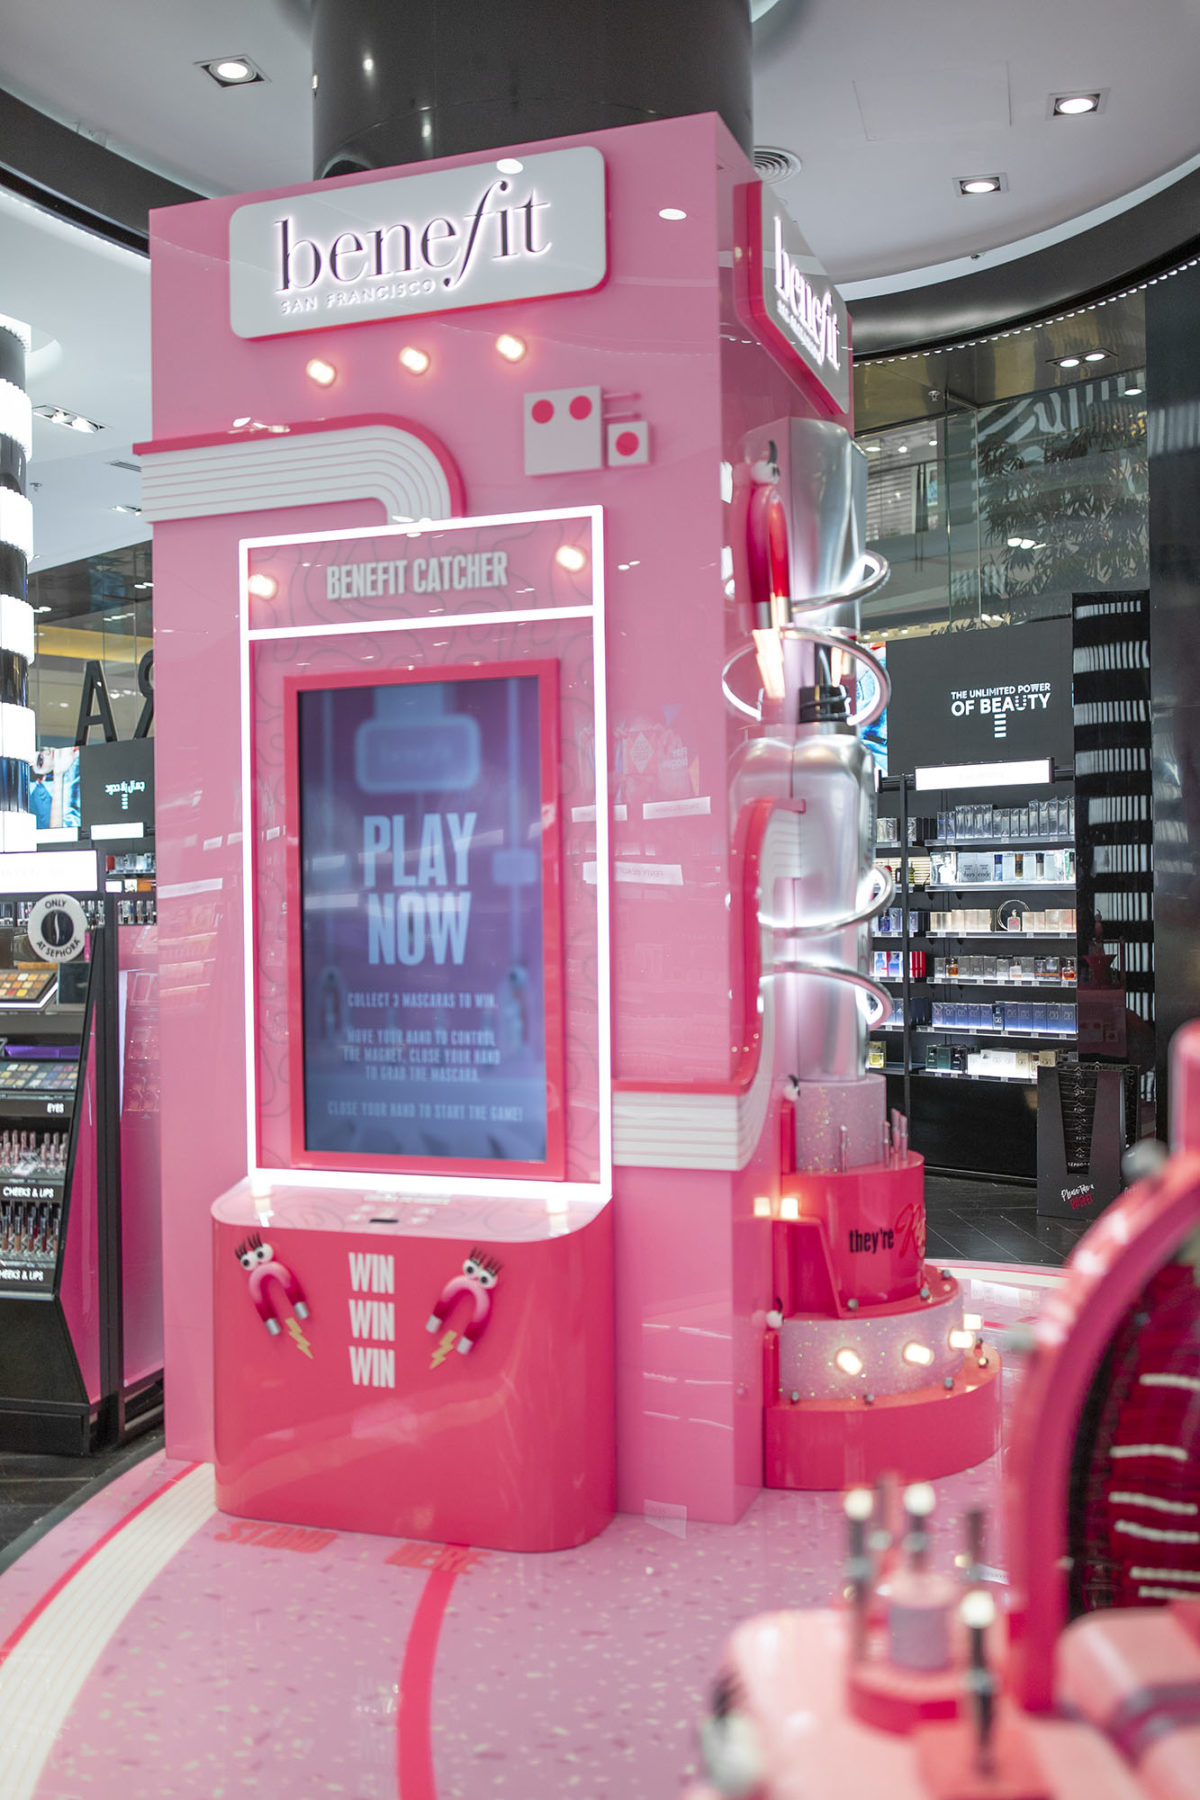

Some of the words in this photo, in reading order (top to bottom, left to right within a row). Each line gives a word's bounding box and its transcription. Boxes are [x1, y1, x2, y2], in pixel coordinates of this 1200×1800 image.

[274, 180, 552, 292] benefit
[280, 295, 318, 316] SAN
[327, 278, 436, 309] FRANCISCO
[774, 215, 841, 370] benefit
[326, 559, 407, 600] BENEFIT
[413, 551, 508, 594] CATCHER
[951, 689, 968, 700] THE
[969, 686, 1016, 699] UNLIMITED
[1018, 682, 1051, 694] POWER
[951, 700, 975, 717] OF
[980, 692, 1051, 714] BEAUTY
[363, 812, 478, 887] PLAY
[45, 898, 67, 909] ONLY
[368, 891, 472, 966] NOW
[36, 941, 46, 951] AT
[45, 938, 80, 958] SEPHORA
[347, 992, 389, 1008] COLLECT
[402, 993, 455, 1008] MASCARAS
[458, 994, 470, 1008] TO
[346, 1029, 372, 1044] MOVE
[377, 1029, 402, 1045] YOUR
[435, 1030, 448, 1045] TO
[343, 1047, 361, 1062] THE
[444, 1048, 471, 1064] YOUR
[365, 1065, 377, 1081] TO
[47, 1102, 65, 1114] EYES
[327, 1100, 358, 1116] CLOSE
[361, 1101, 387, 1117] YOUR
[419, 1103, 431, 1119] TO
[434, 1103, 465, 1120] START
[469, 1104, 487, 1120] THE
[2, 1185, 31, 1198] CHEEKS
[39, 1187, 55, 1199] LIPS
[848, 1227, 895, 1255] they're
[0, 1268, 21, 1281] HEEKS
[29, 1269, 44, 1282] LIPS
[348, 1252, 395, 1294] WIN
[348, 1299, 395, 1341] WIN
[348, 1346, 395, 1388] WIN
[213, 1521, 339, 1554] STAND
[384, 1541, 493, 1575] HERE
